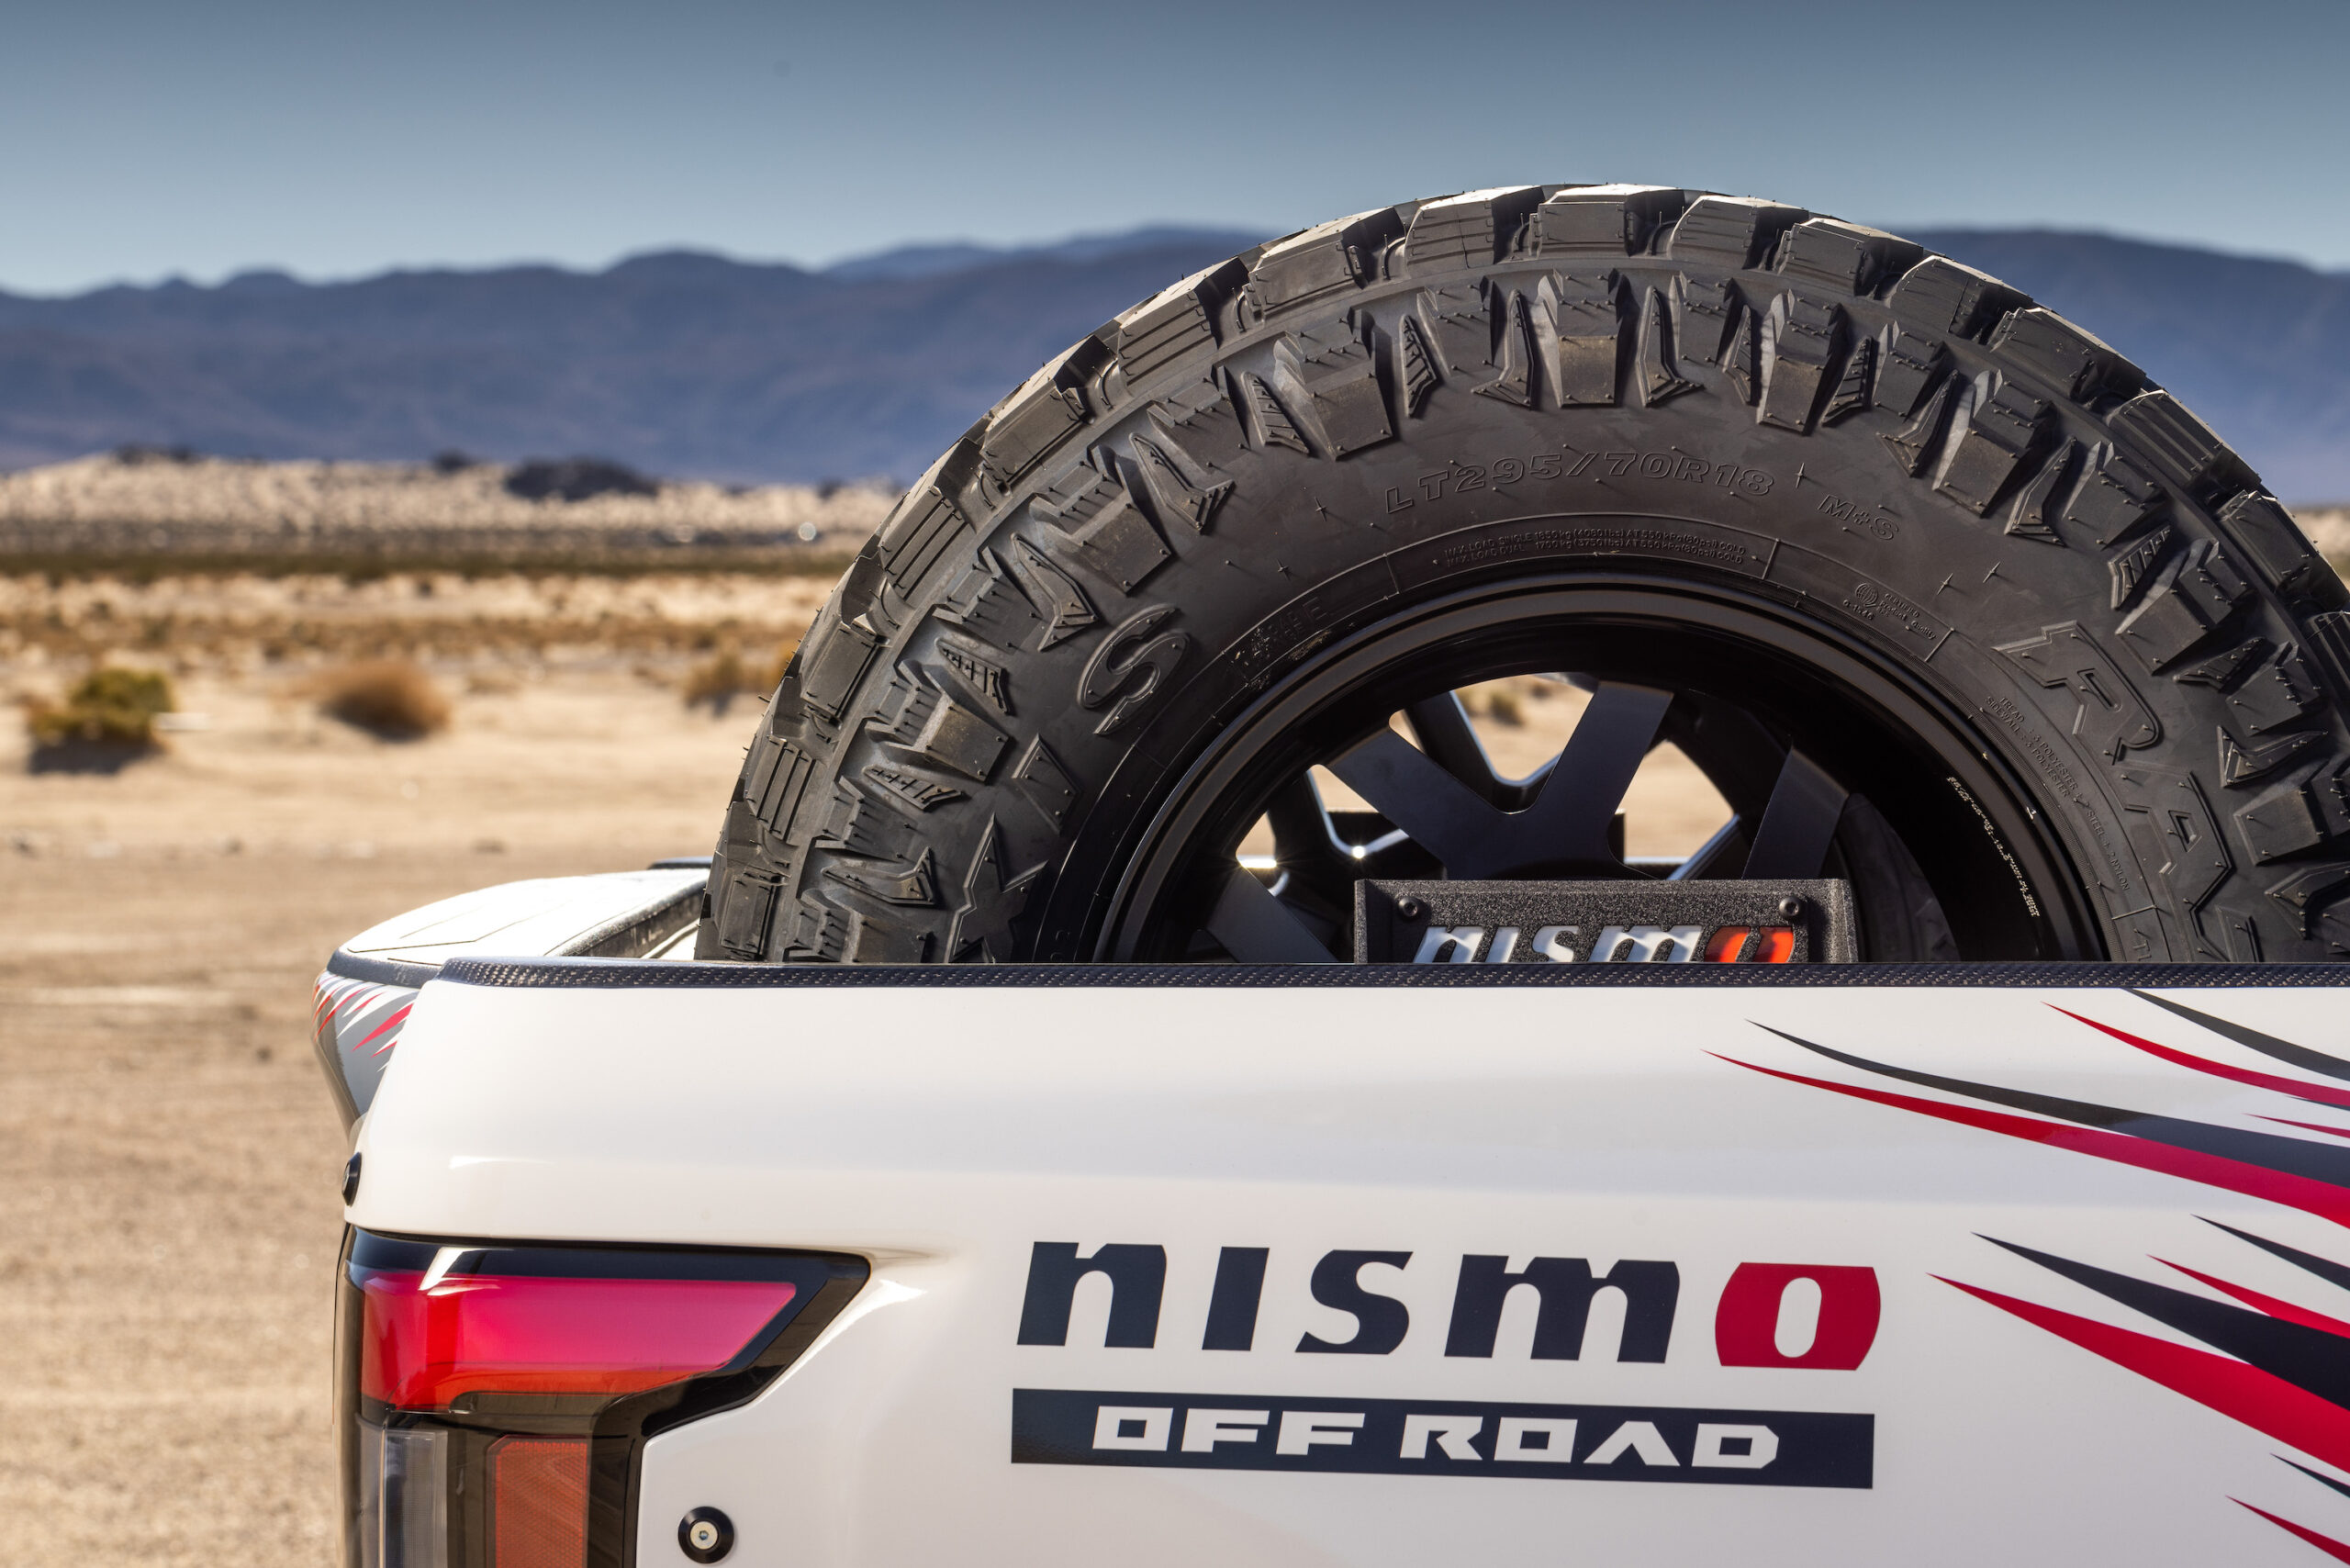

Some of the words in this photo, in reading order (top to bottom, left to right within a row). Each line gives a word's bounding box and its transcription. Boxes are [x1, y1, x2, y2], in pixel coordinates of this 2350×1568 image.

[1385, 452, 1774, 514] LT295/70R18
[1469, 539, 1495, 550] LOAD
[1498, 532, 1532, 544] SINGLE
[1627, 529, 1639, 537] AT
[1719, 542, 1745, 554] COLD
[1818, 495, 1899, 541] M+S
[1471, 548, 1497, 559] LOAD
[1500, 544, 1524, 554] DUAL
[1535, 541, 1558, 549] 1700
[1625, 539, 1638, 547] AT
[1717, 551, 1743, 564] COLD
[1879, 600, 1908, 621] Product
[1910, 620, 1936, 640] Quality
[1986, 696, 2020, 735] SIDEWALL
[2031, 746, 2070, 798] POLYESTER
[1999, 697, 2025, 723] TREAD
[2039, 742, 2078, 790] POLYESTER
[2086, 811, 2105, 842] STEEL
[2110, 859, 2130, 891] NYLON
[1017, 1241, 1881, 1371] nismo
[1092, 1406, 1366, 1456] OFF
[1399, 1414, 1780, 1470] ROAD
